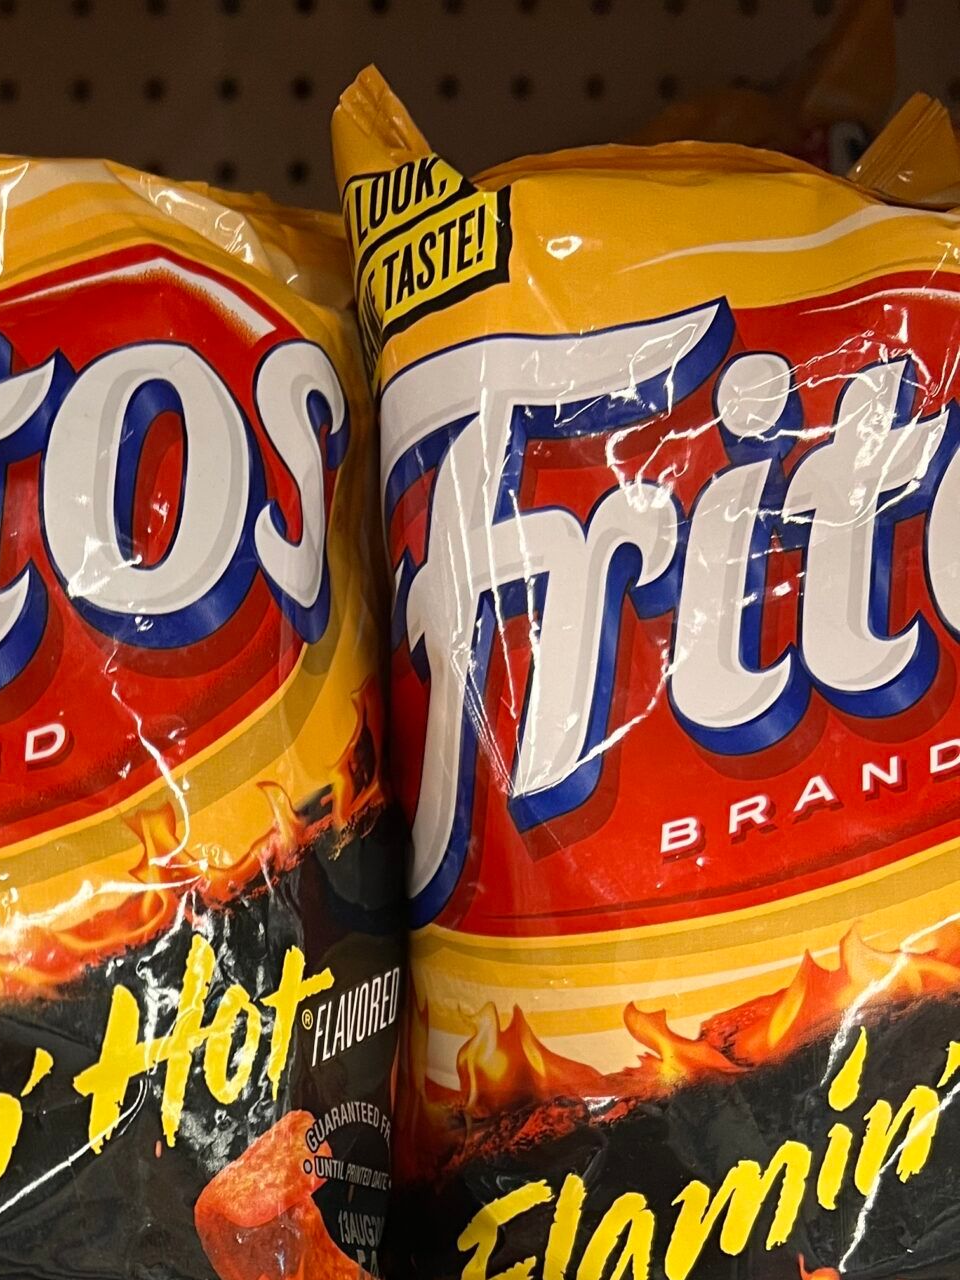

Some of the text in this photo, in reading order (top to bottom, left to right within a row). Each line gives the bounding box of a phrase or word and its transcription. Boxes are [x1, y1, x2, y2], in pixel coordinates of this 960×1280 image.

[354, 156, 449, 248] LOOK,
[383, 204, 486, 312] TASTE!
[378, 298, 960, 898] Frit
[660, 738, 960, 853] BRAND
[73, 934, 400, 1154] Hot FLAVORED
[306, 1101, 380, 1152] GUARANTEED
[315, 1157, 344, 1180] UNTIL
